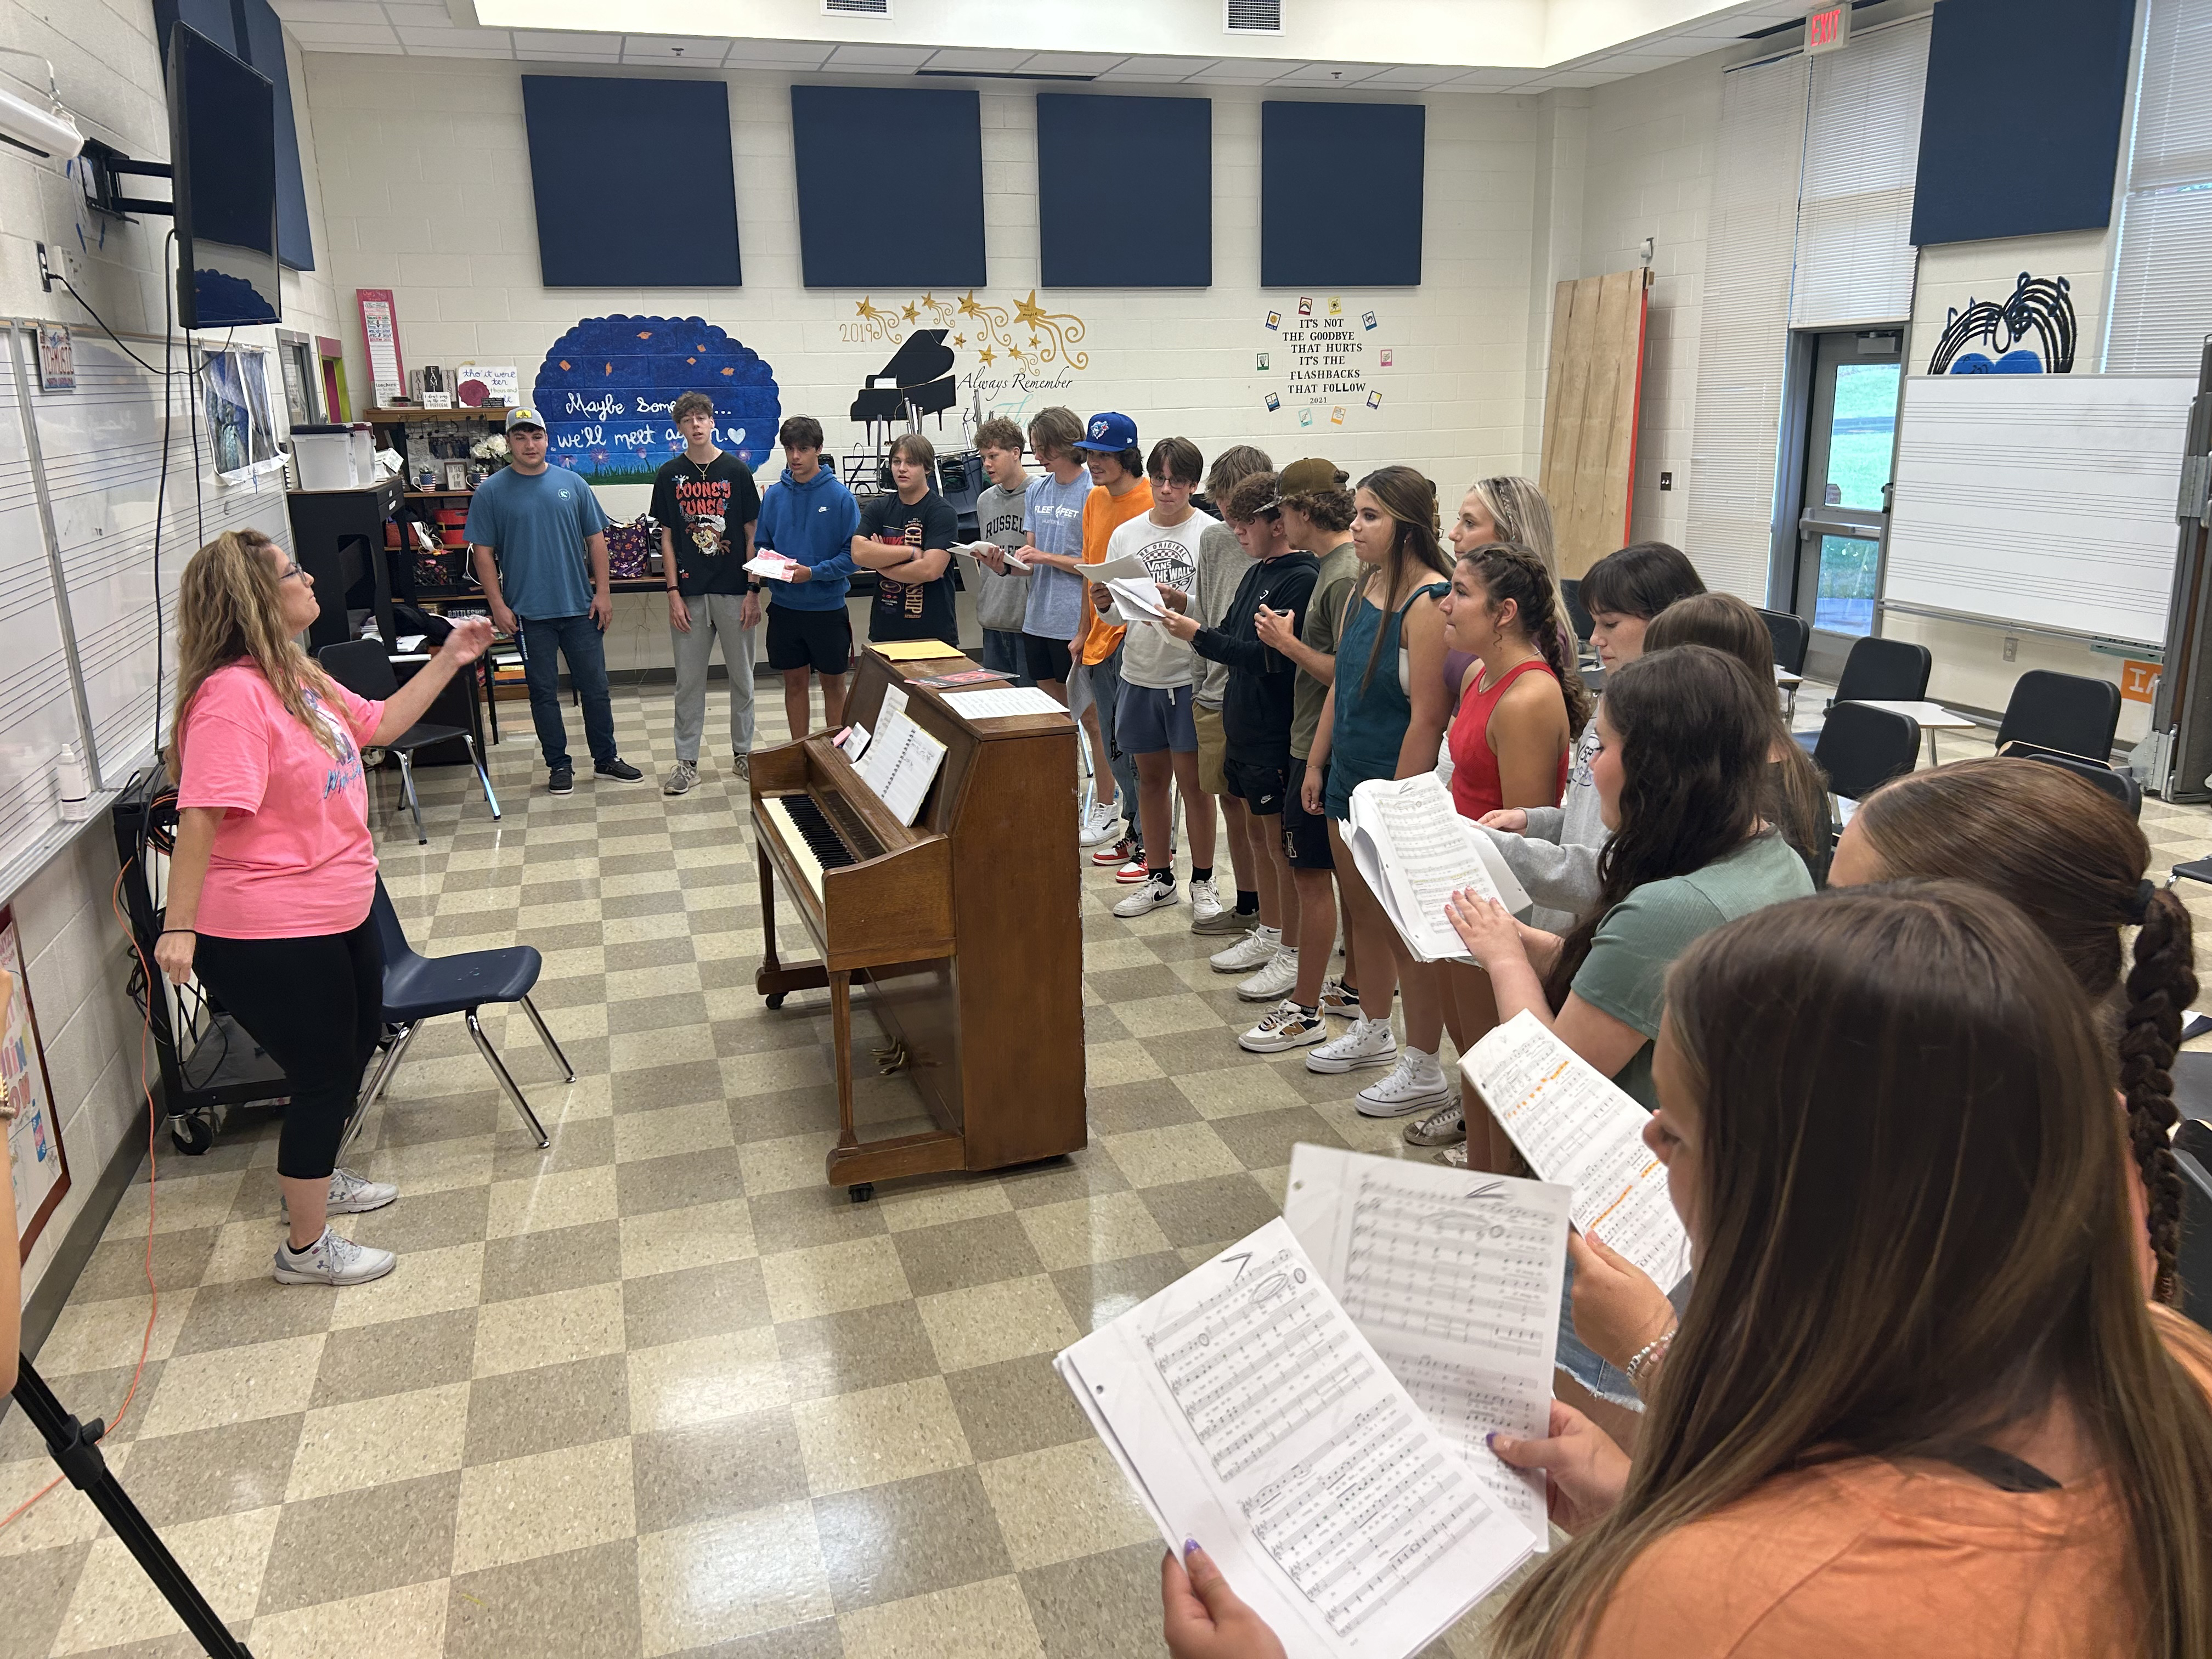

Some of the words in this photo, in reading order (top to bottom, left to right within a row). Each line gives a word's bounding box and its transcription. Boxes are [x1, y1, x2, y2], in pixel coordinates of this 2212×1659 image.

[1811, 9, 1841, 47] EXIT
[1299, 319, 1318, 329] IT'S
[1324, 318, 1344, 328] NOT
[839, 323, 873, 342] 2019
[1282, 332, 1305, 341] THE
[1310, 331, 1355, 341] GOODBYE
[1291, 343, 1321, 353] THAT
[1326, 343, 1362, 353] HURTS
[1299, 356, 1318, 365] IT'S
[1323, 356, 1345, 365] THE
[430, 366, 438, 392] FAMI
[484, 369, 493, 377] it
[1290, 369, 1360, 380] FLASHBACKS
[415, 371, 423, 400] FAITH
[957, 365, 1008, 402] Always
[1012, 365, 1074, 393] Remember
[1288, 384, 1318, 394] THAT
[1323, 383, 1366, 392] FOLLOW
[566, 392, 625, 422] Maybe
[557, 425, 607, 448] we'll
[614, 424, 656, 450] meet
[665, 428, 729, 450] agn.
[675, 481, 731, 500] LOONEY
[679, 498, 725, 515] TUNES
[1035, 505, 1054, 514] FLEET
[1060, 507, 1080, 518] FEET
[985, 515, 1028, 539] RUSSEL
[1139, 549, 1149, 557] HE
[1153, 543, 1187, 557] ORIGINAL
[1147, 559, 1172, 571] VANS
[1150, 569, 1169, 583] THE
